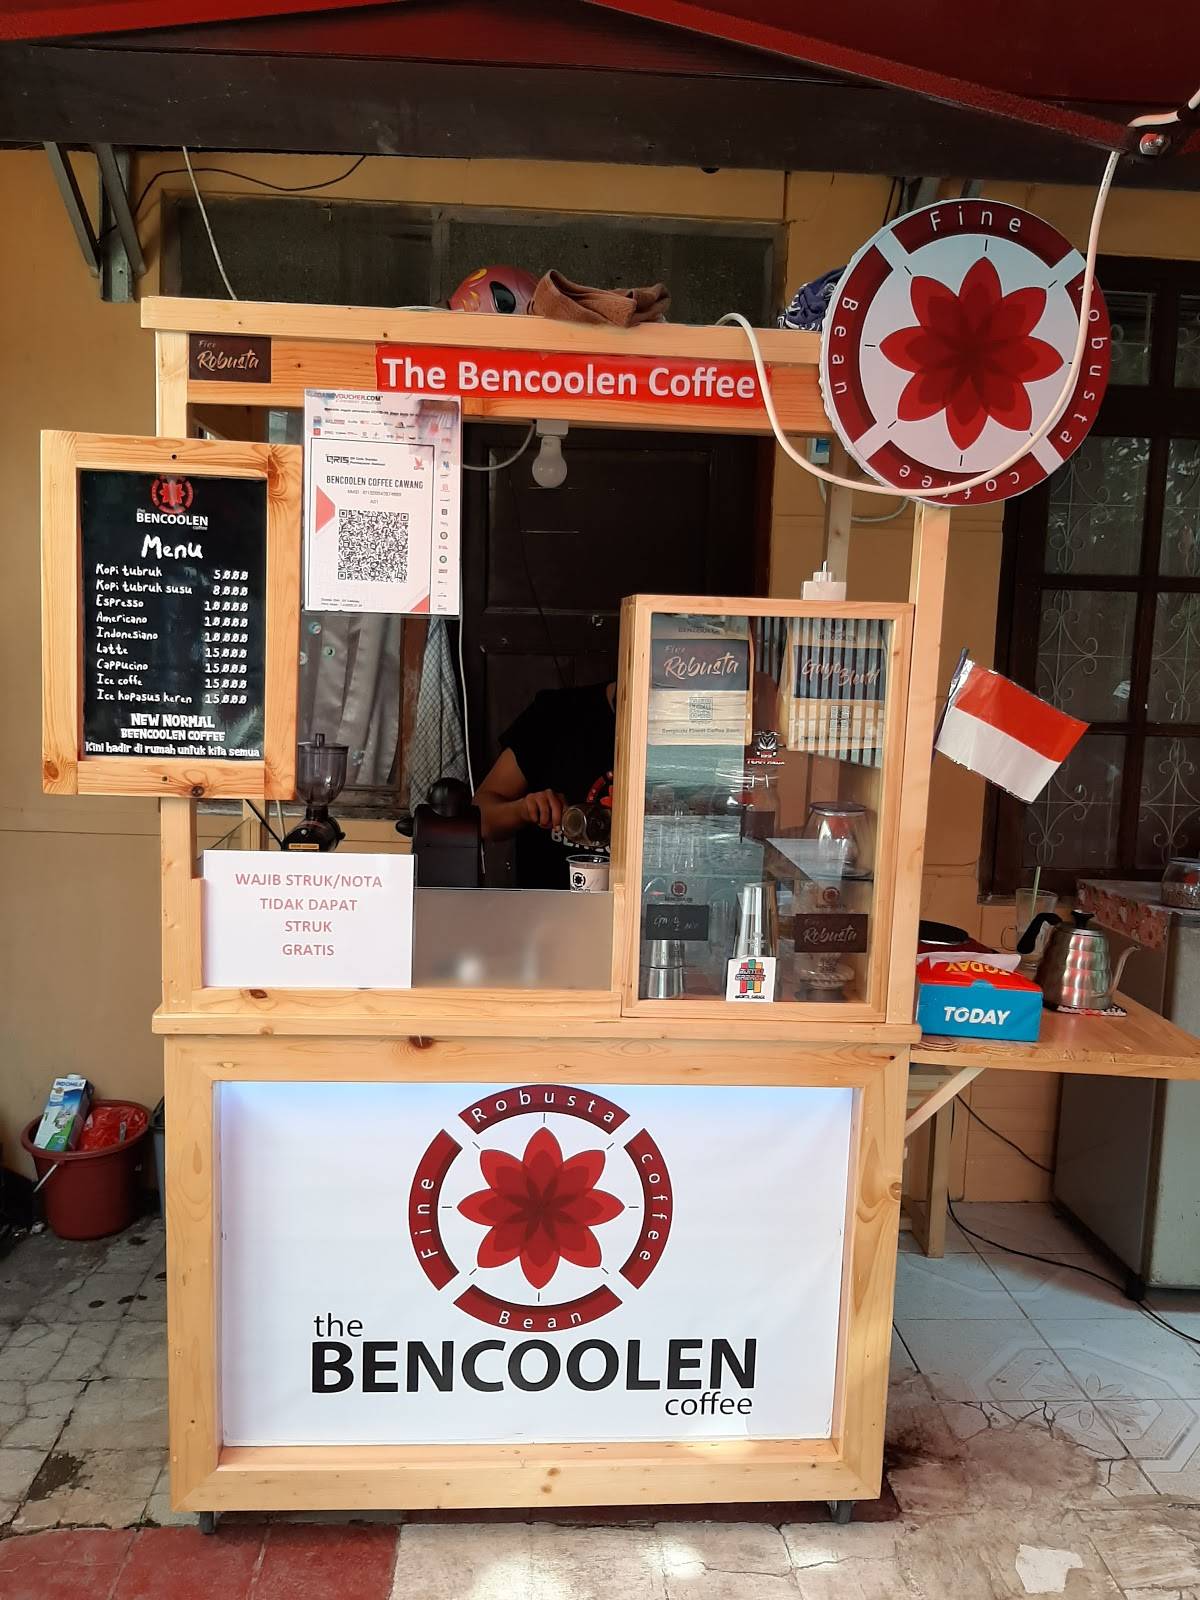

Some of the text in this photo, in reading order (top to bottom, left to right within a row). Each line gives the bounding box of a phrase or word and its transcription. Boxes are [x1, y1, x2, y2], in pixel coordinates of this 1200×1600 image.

[929, 205, 1021, 232] Fine
[831, 296, 859, 395] Bean
[197, 349, 260, 371] Robusta
[382, 357, 756, 399] The Bencoolen Coffee
[326, 475, 424, 489] BENCOOLEN COFFEE CAWANG
[136, 512, 209, 526] BENCOOLEN
[141, 534, 203, 559] Menu
[96, 563, 119, 579] Kopi
[122, 565, 162, 577] tubruk
[96, 579, 119, 594] Kopi
[122, 581, 163, 593] tubruk
[165, 585, 192, 594] susu
[96, 594, 144, 607] Espresso
[96, 611, 148, 623] Americano
[96, 626, 158, 641] Indonesiano
[96, 643, 128, 655] Latte
[96, 658, 148, 671] Cappucino
[664, 652, 739, 680] Robusta
[96, 673, 115, 685] Ice
[118, 674, 143, 686] coffe
[96, 689, 115, 701] Ice
[163, 692, 192, 704] keren
[130, 713, 215, 729] NEW NORMAL
[120, 728, 226, 742] BEENCOOLEN COFFEE
[85, 741, 260, 757] Kini hadir di rumah untuk kita semua
[235, 873, 383, 889] WAJIB STRUK/NOTA
[260, 898, 358, 911] TIDAK DAPAT
[284, 920, 332, 932] STRUK
[282, 944, 335, 956] GRATIS
[943, 1006, 1011, 1026] TODAY
[471, 1089, 615, 1123] Robusta
[639, 1153, 668, 1260] coffee
[414, 1178, 439, 1259] Fine
[313, 1313, 363, 1338] the
[498, 1310, 582, 1329] Bean
[311, 1338, 757, 1394] BENCOOLEN
[665, 1391, 753, 1416] coffee
